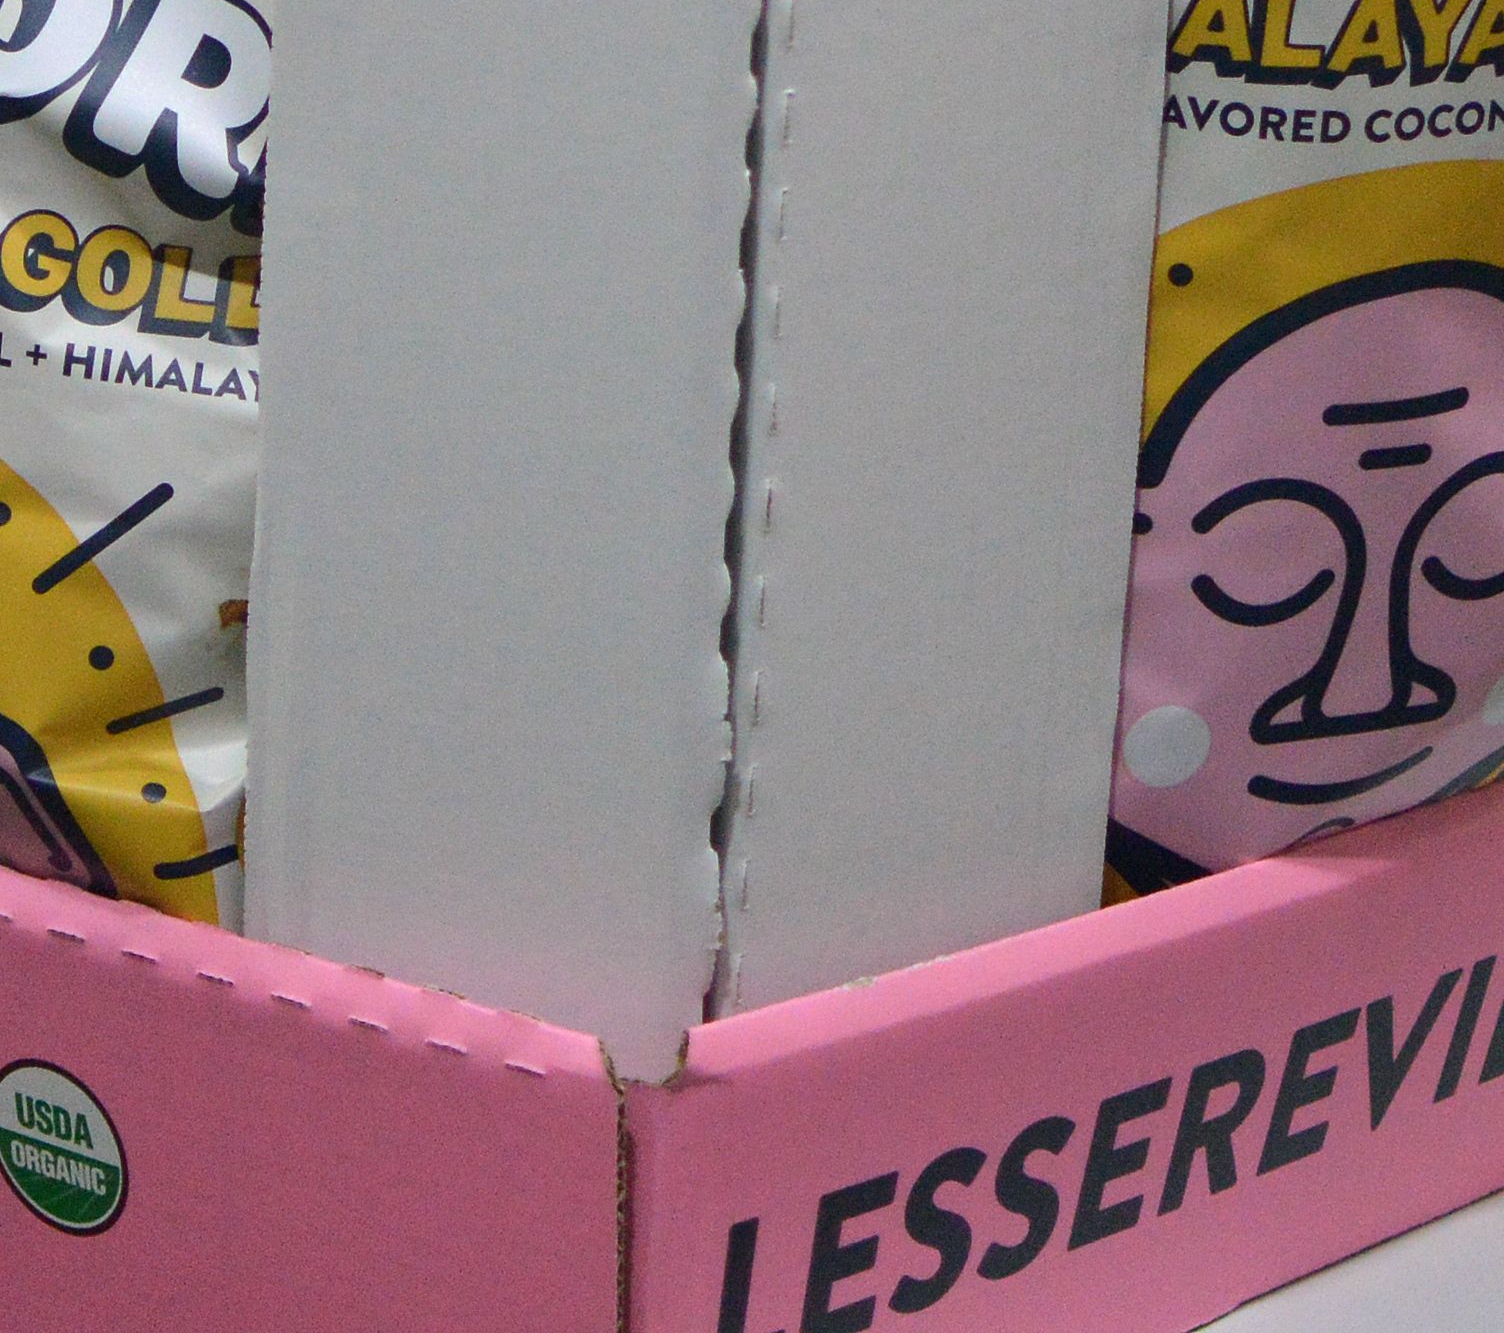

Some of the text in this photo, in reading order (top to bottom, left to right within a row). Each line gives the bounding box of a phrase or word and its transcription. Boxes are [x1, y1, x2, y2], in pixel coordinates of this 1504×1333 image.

[25, 342, 48, 367] +
[14, 1091, 95, 1151] USDA
[8, 1138, 109, 1198] ORGANIC
